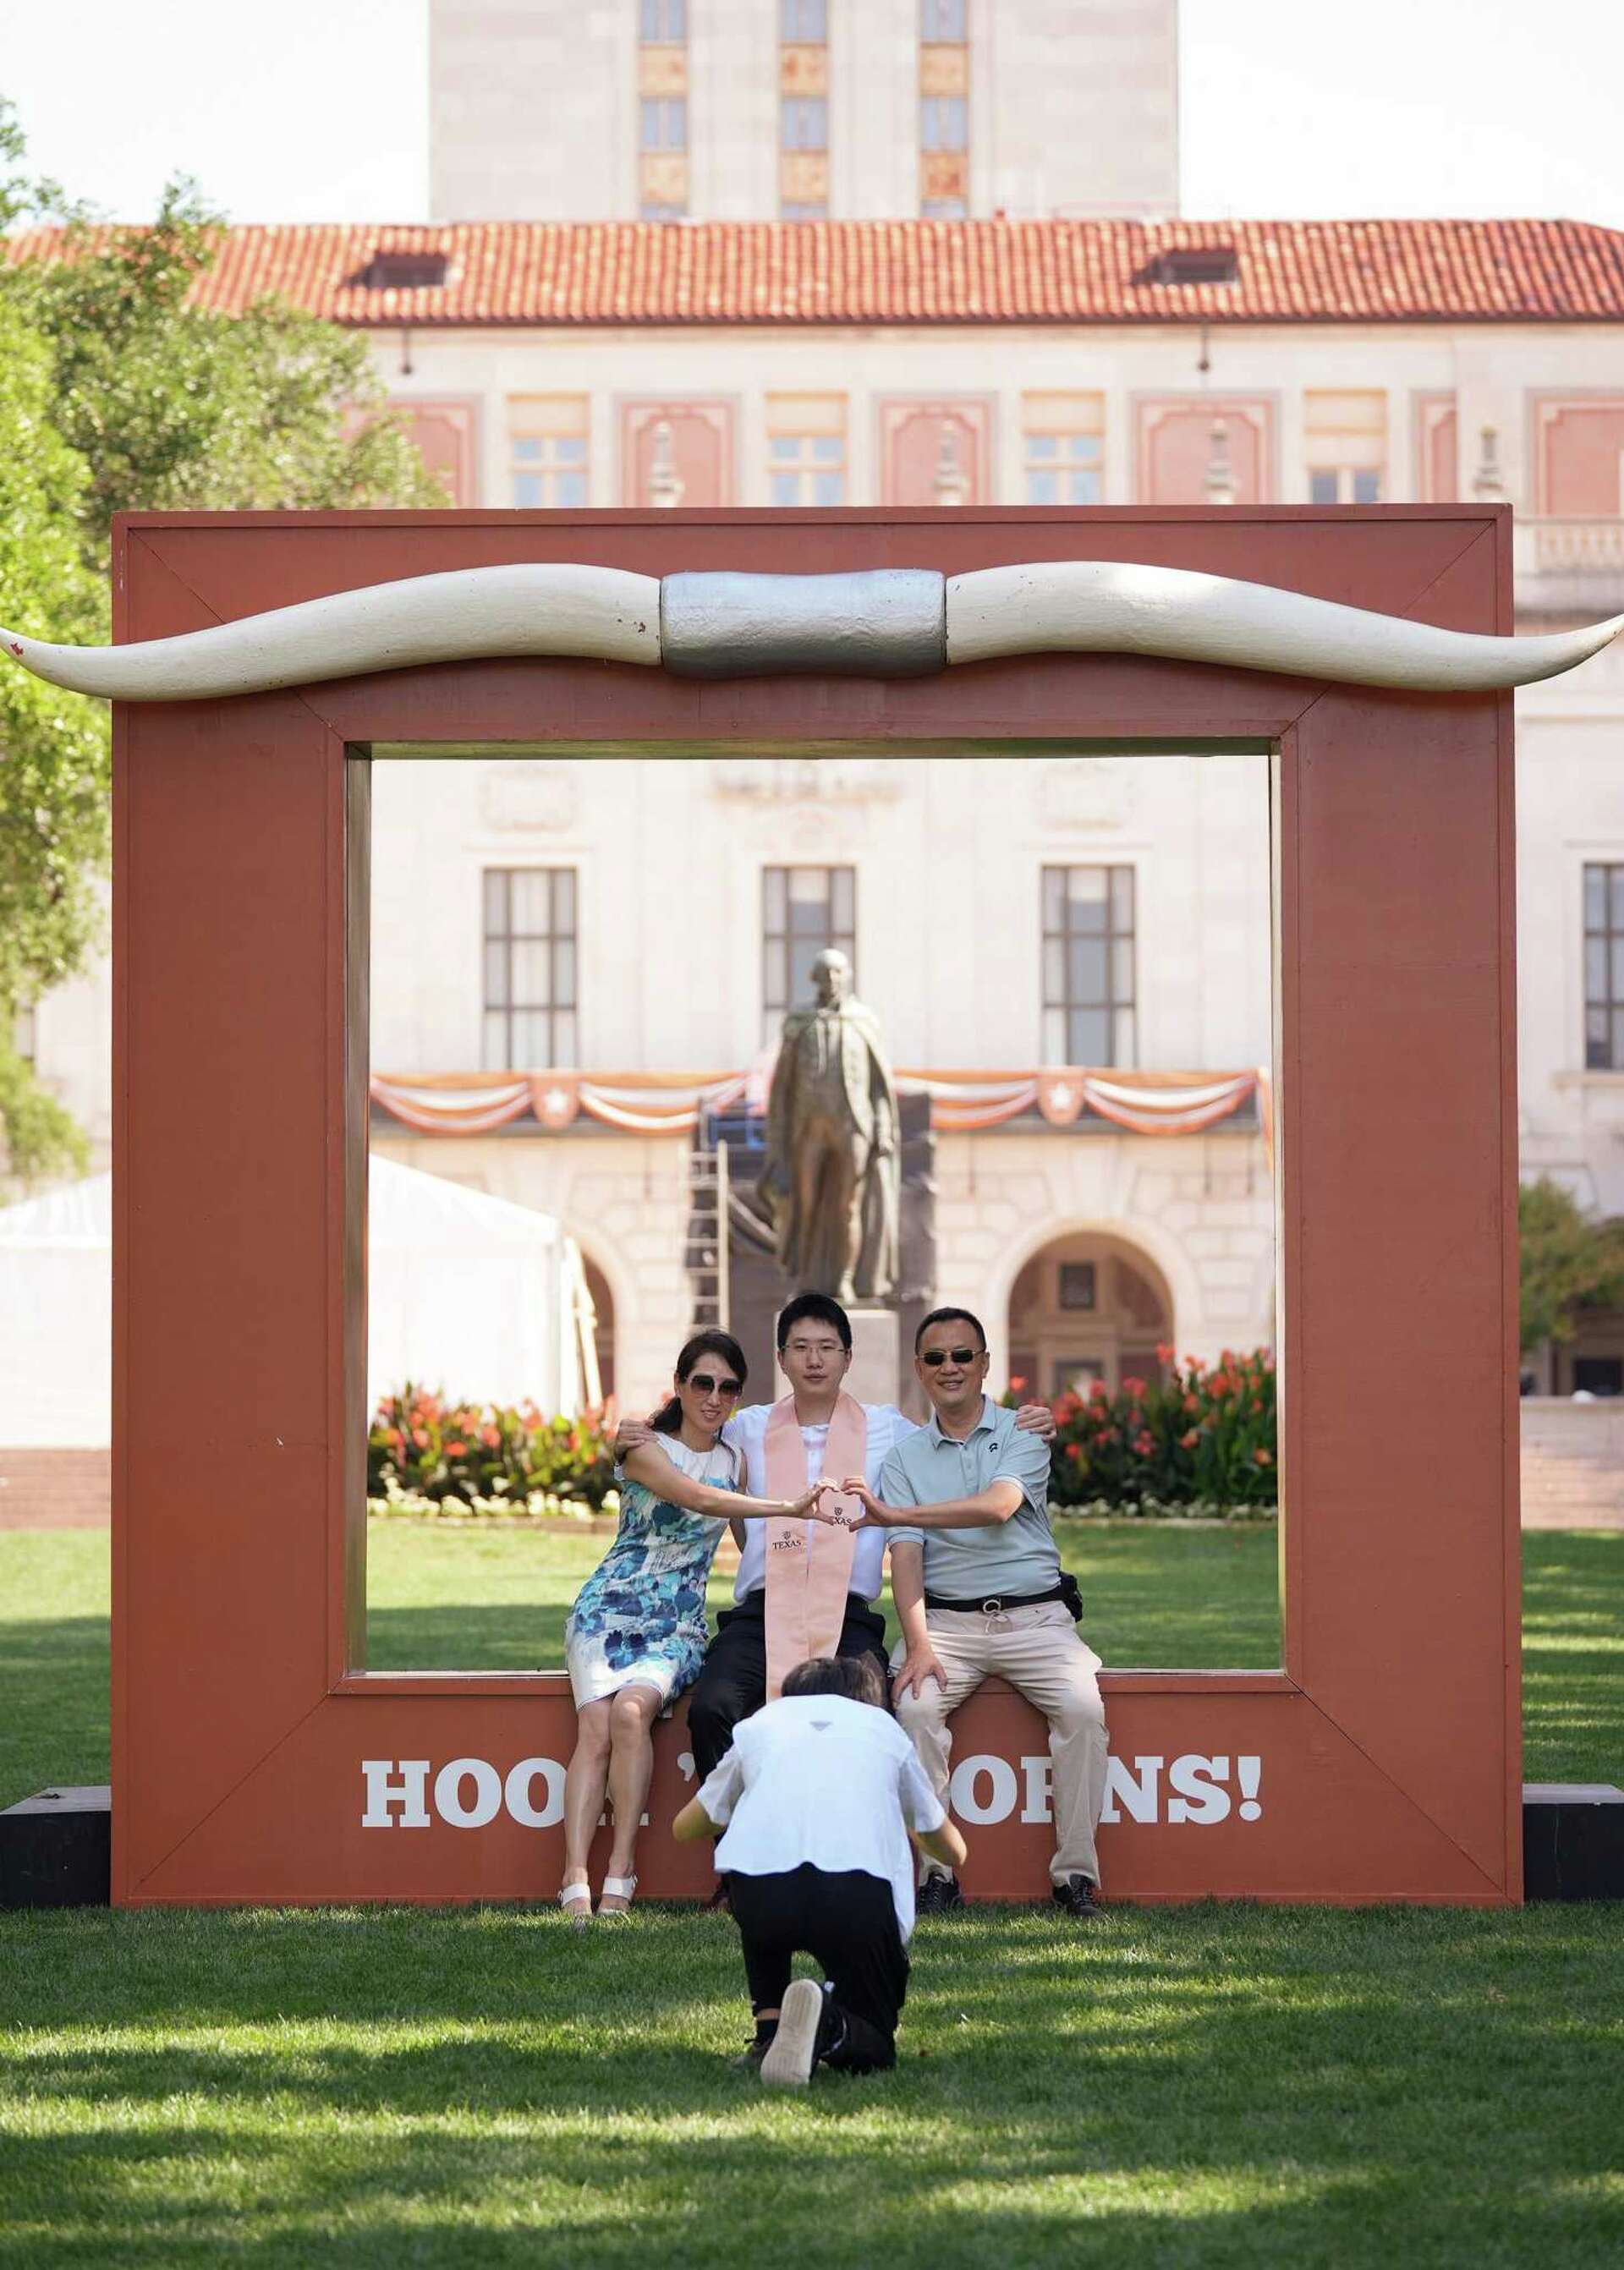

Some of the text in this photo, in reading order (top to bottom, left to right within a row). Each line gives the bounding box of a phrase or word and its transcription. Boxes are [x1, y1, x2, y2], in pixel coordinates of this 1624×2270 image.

[833, 1516, 853, 1526] XAS
[362, 1757, 650, 1828] HOO
[951, 1753, 1262, 1825] ONS!
